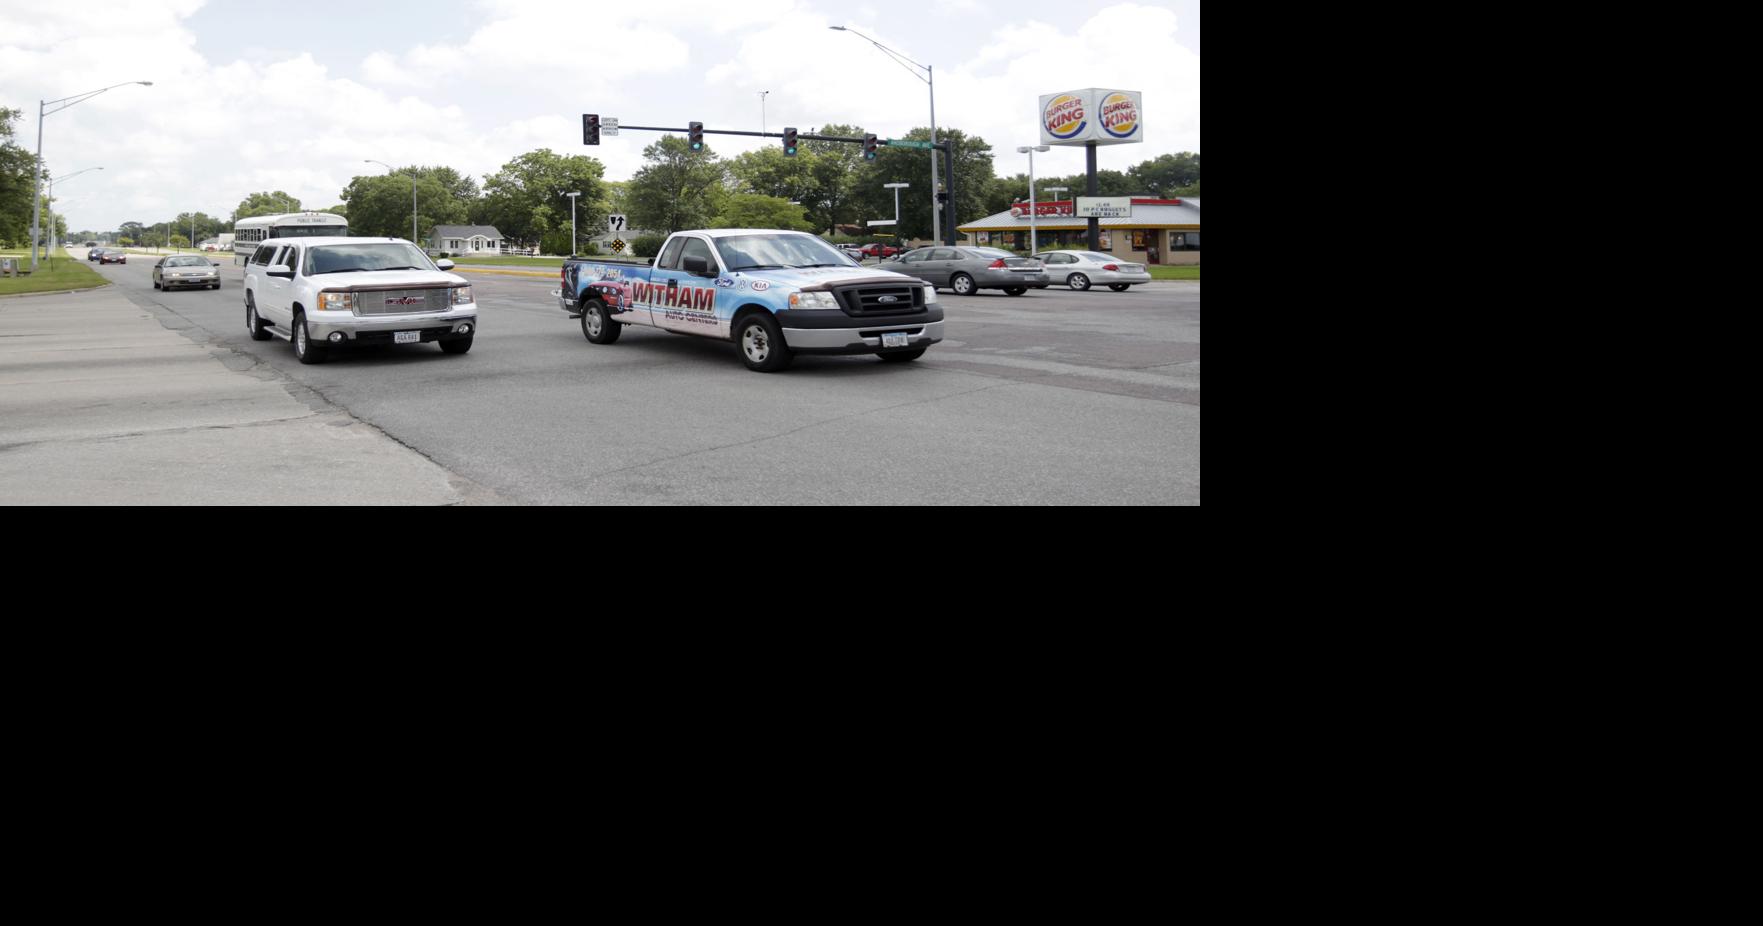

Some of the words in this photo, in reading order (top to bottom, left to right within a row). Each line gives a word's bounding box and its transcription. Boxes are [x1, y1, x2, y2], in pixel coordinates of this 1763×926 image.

[1046, 98, 1082, 119] BURGER
[1048, 107, 1085, 131] KING
[1104, 110, 1137, 128] KING
[753, 282, 767, 290] KIA
[632, 281, 716, 313] WITHAM
